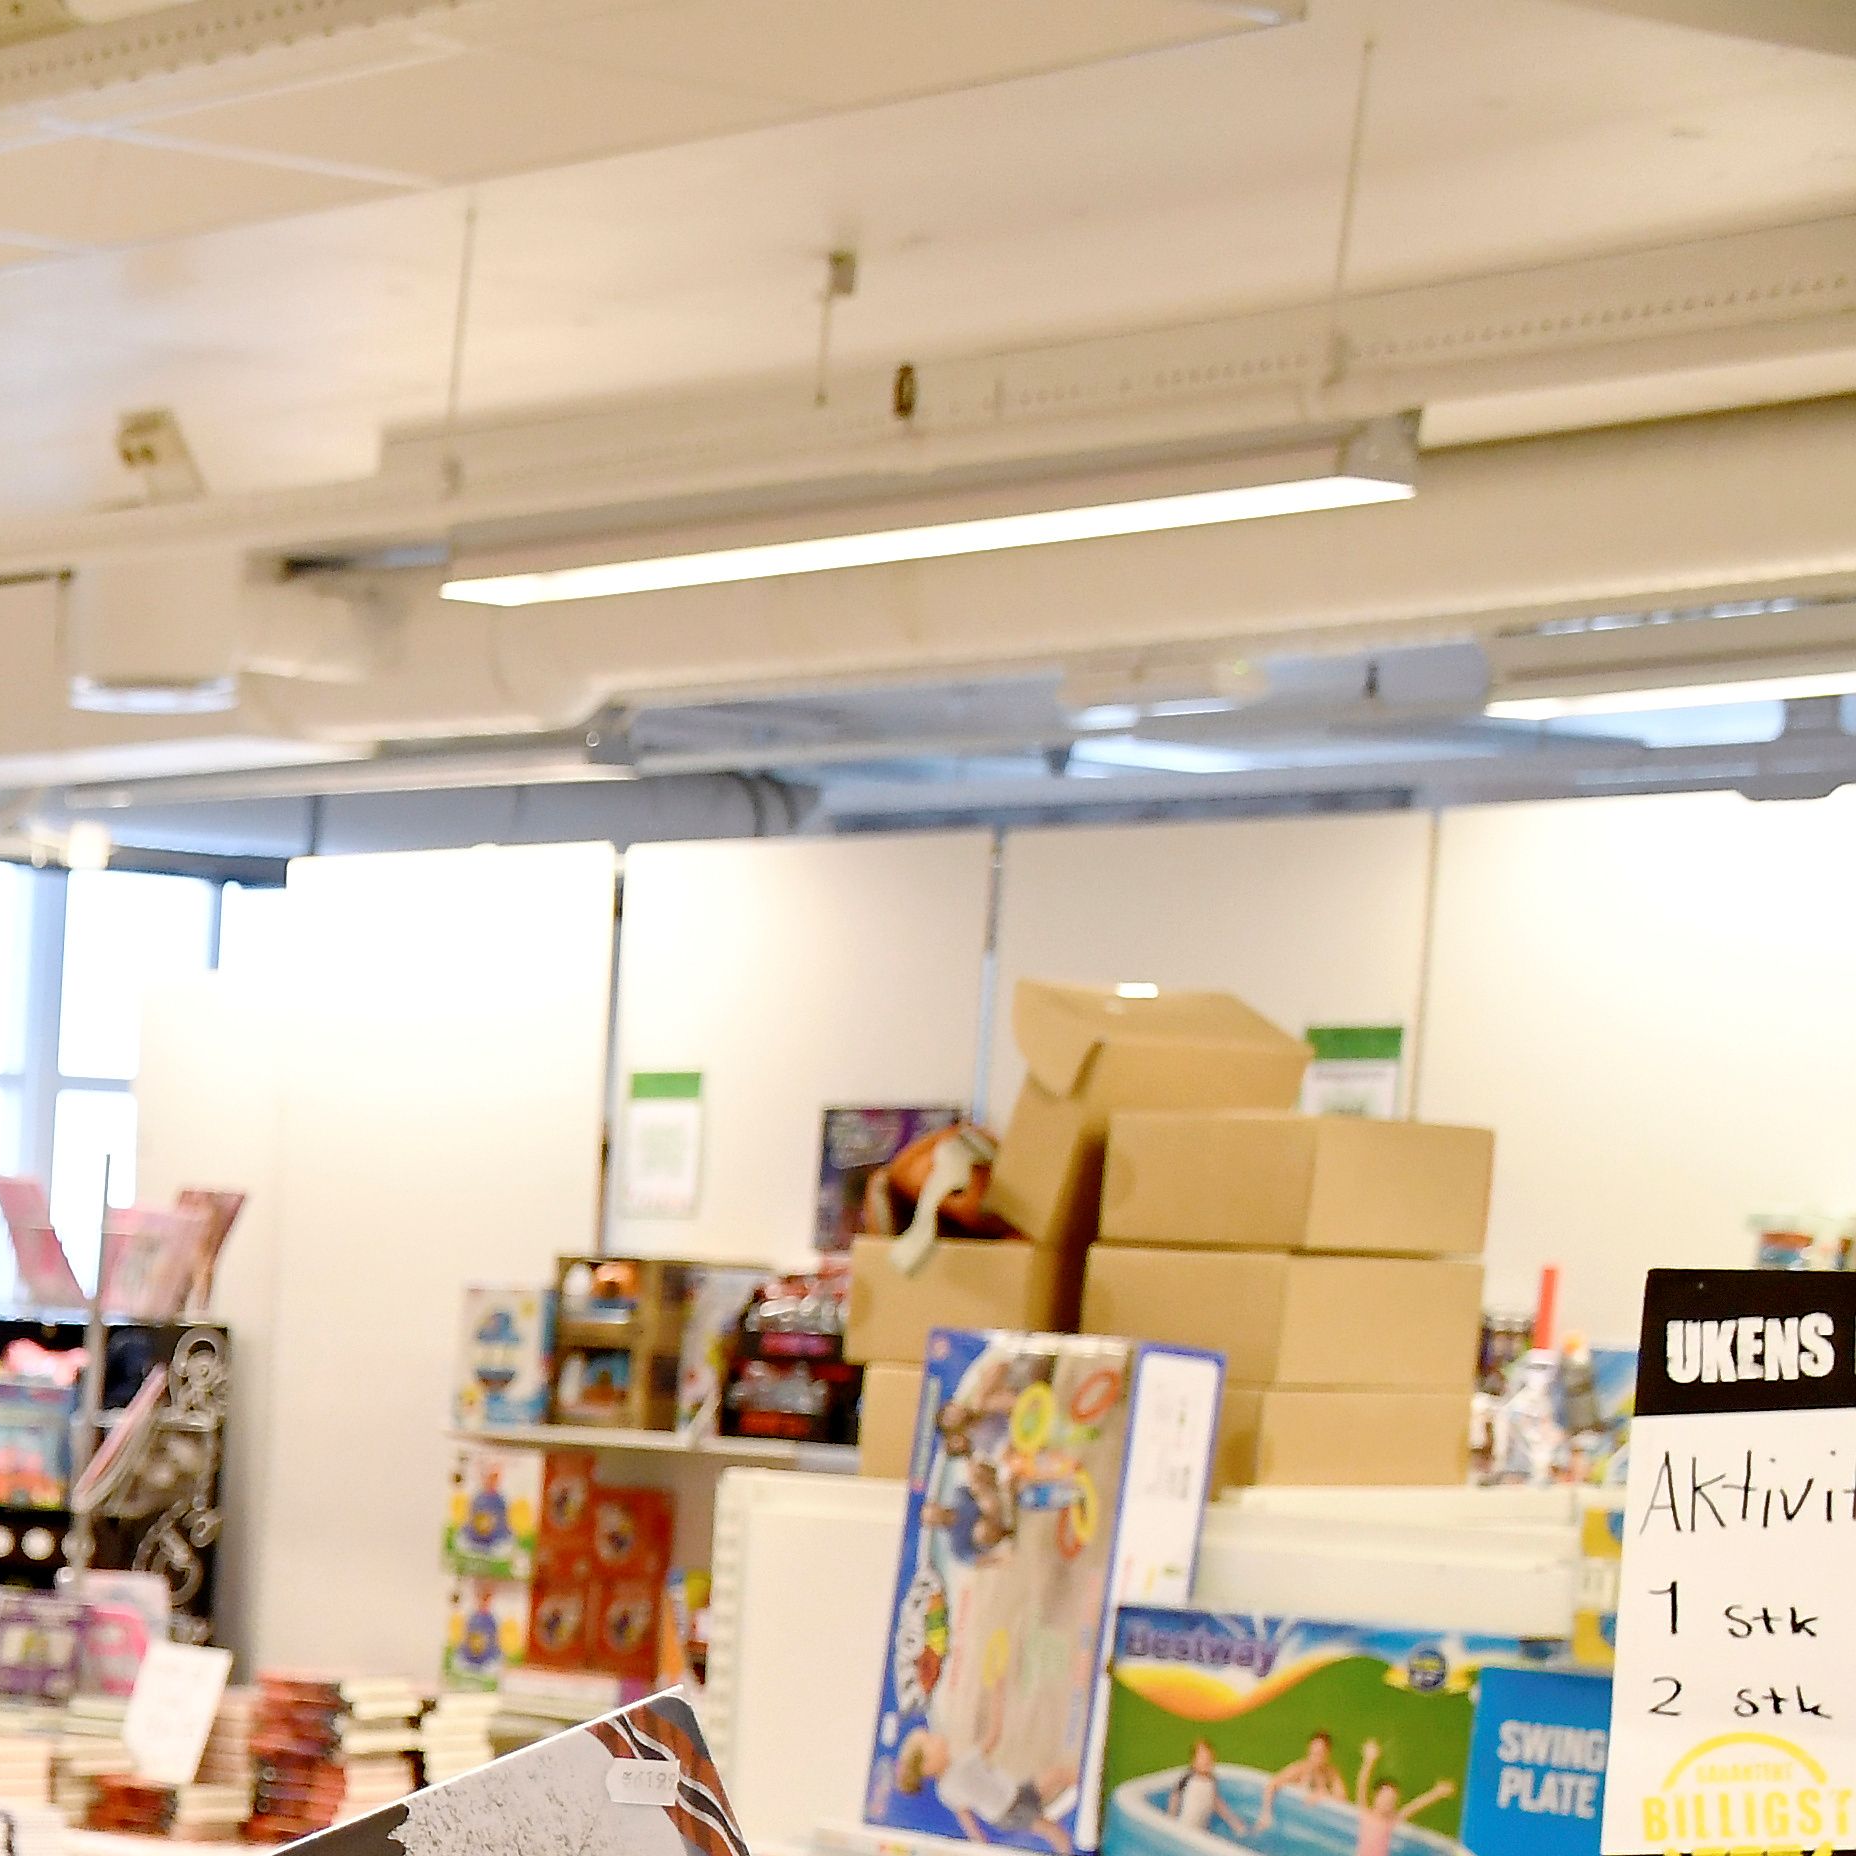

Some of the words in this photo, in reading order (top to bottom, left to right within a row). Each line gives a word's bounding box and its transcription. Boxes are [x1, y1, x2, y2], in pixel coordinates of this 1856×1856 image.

[1667, 1312, 1835, 1384] UKENS
[1649, 1580, 1679, 1635] 1
[1724, 1604, 1820, 1638] stk
[1650, 1676, 1683, 1718] 2
[1733, 1685, 1833, 1721] stk
[1497, 1719, 1606, 1772] SWING
[1497, 1765, 1598, 1820] PLATE
